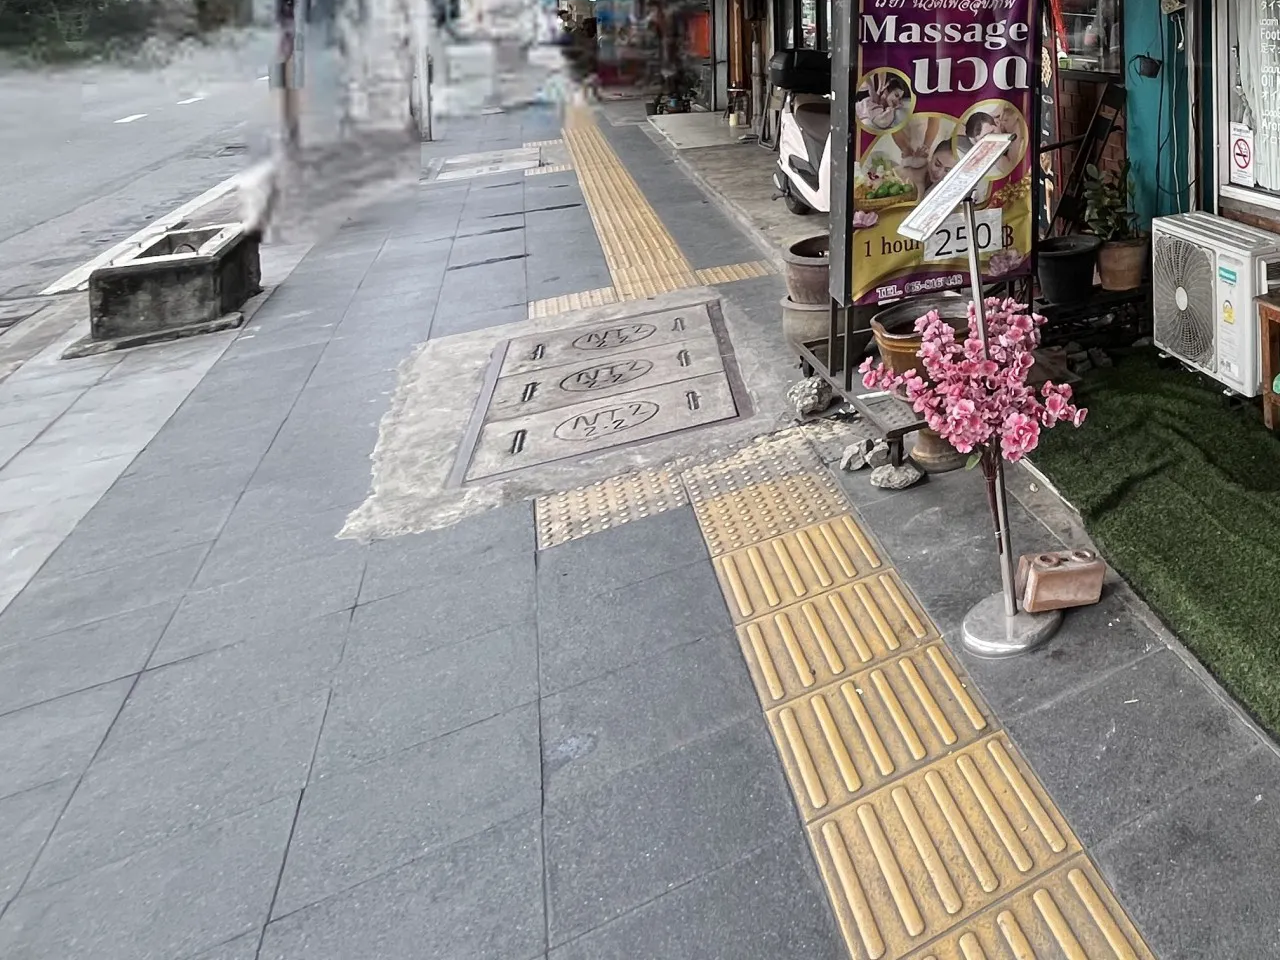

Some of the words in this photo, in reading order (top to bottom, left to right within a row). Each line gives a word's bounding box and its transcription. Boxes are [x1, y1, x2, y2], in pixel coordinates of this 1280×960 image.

[862, 14, 1028, 50] Massage
[1260, 28, 1280, 41] Foot
[913, 55, 1029, 94] นวด
[1261, 75, 1274, 87] Oil
[865, 240, 872, 257] 1
[935, 223, 991, 257] 250
[876, 284, 903, 298] TEL.
